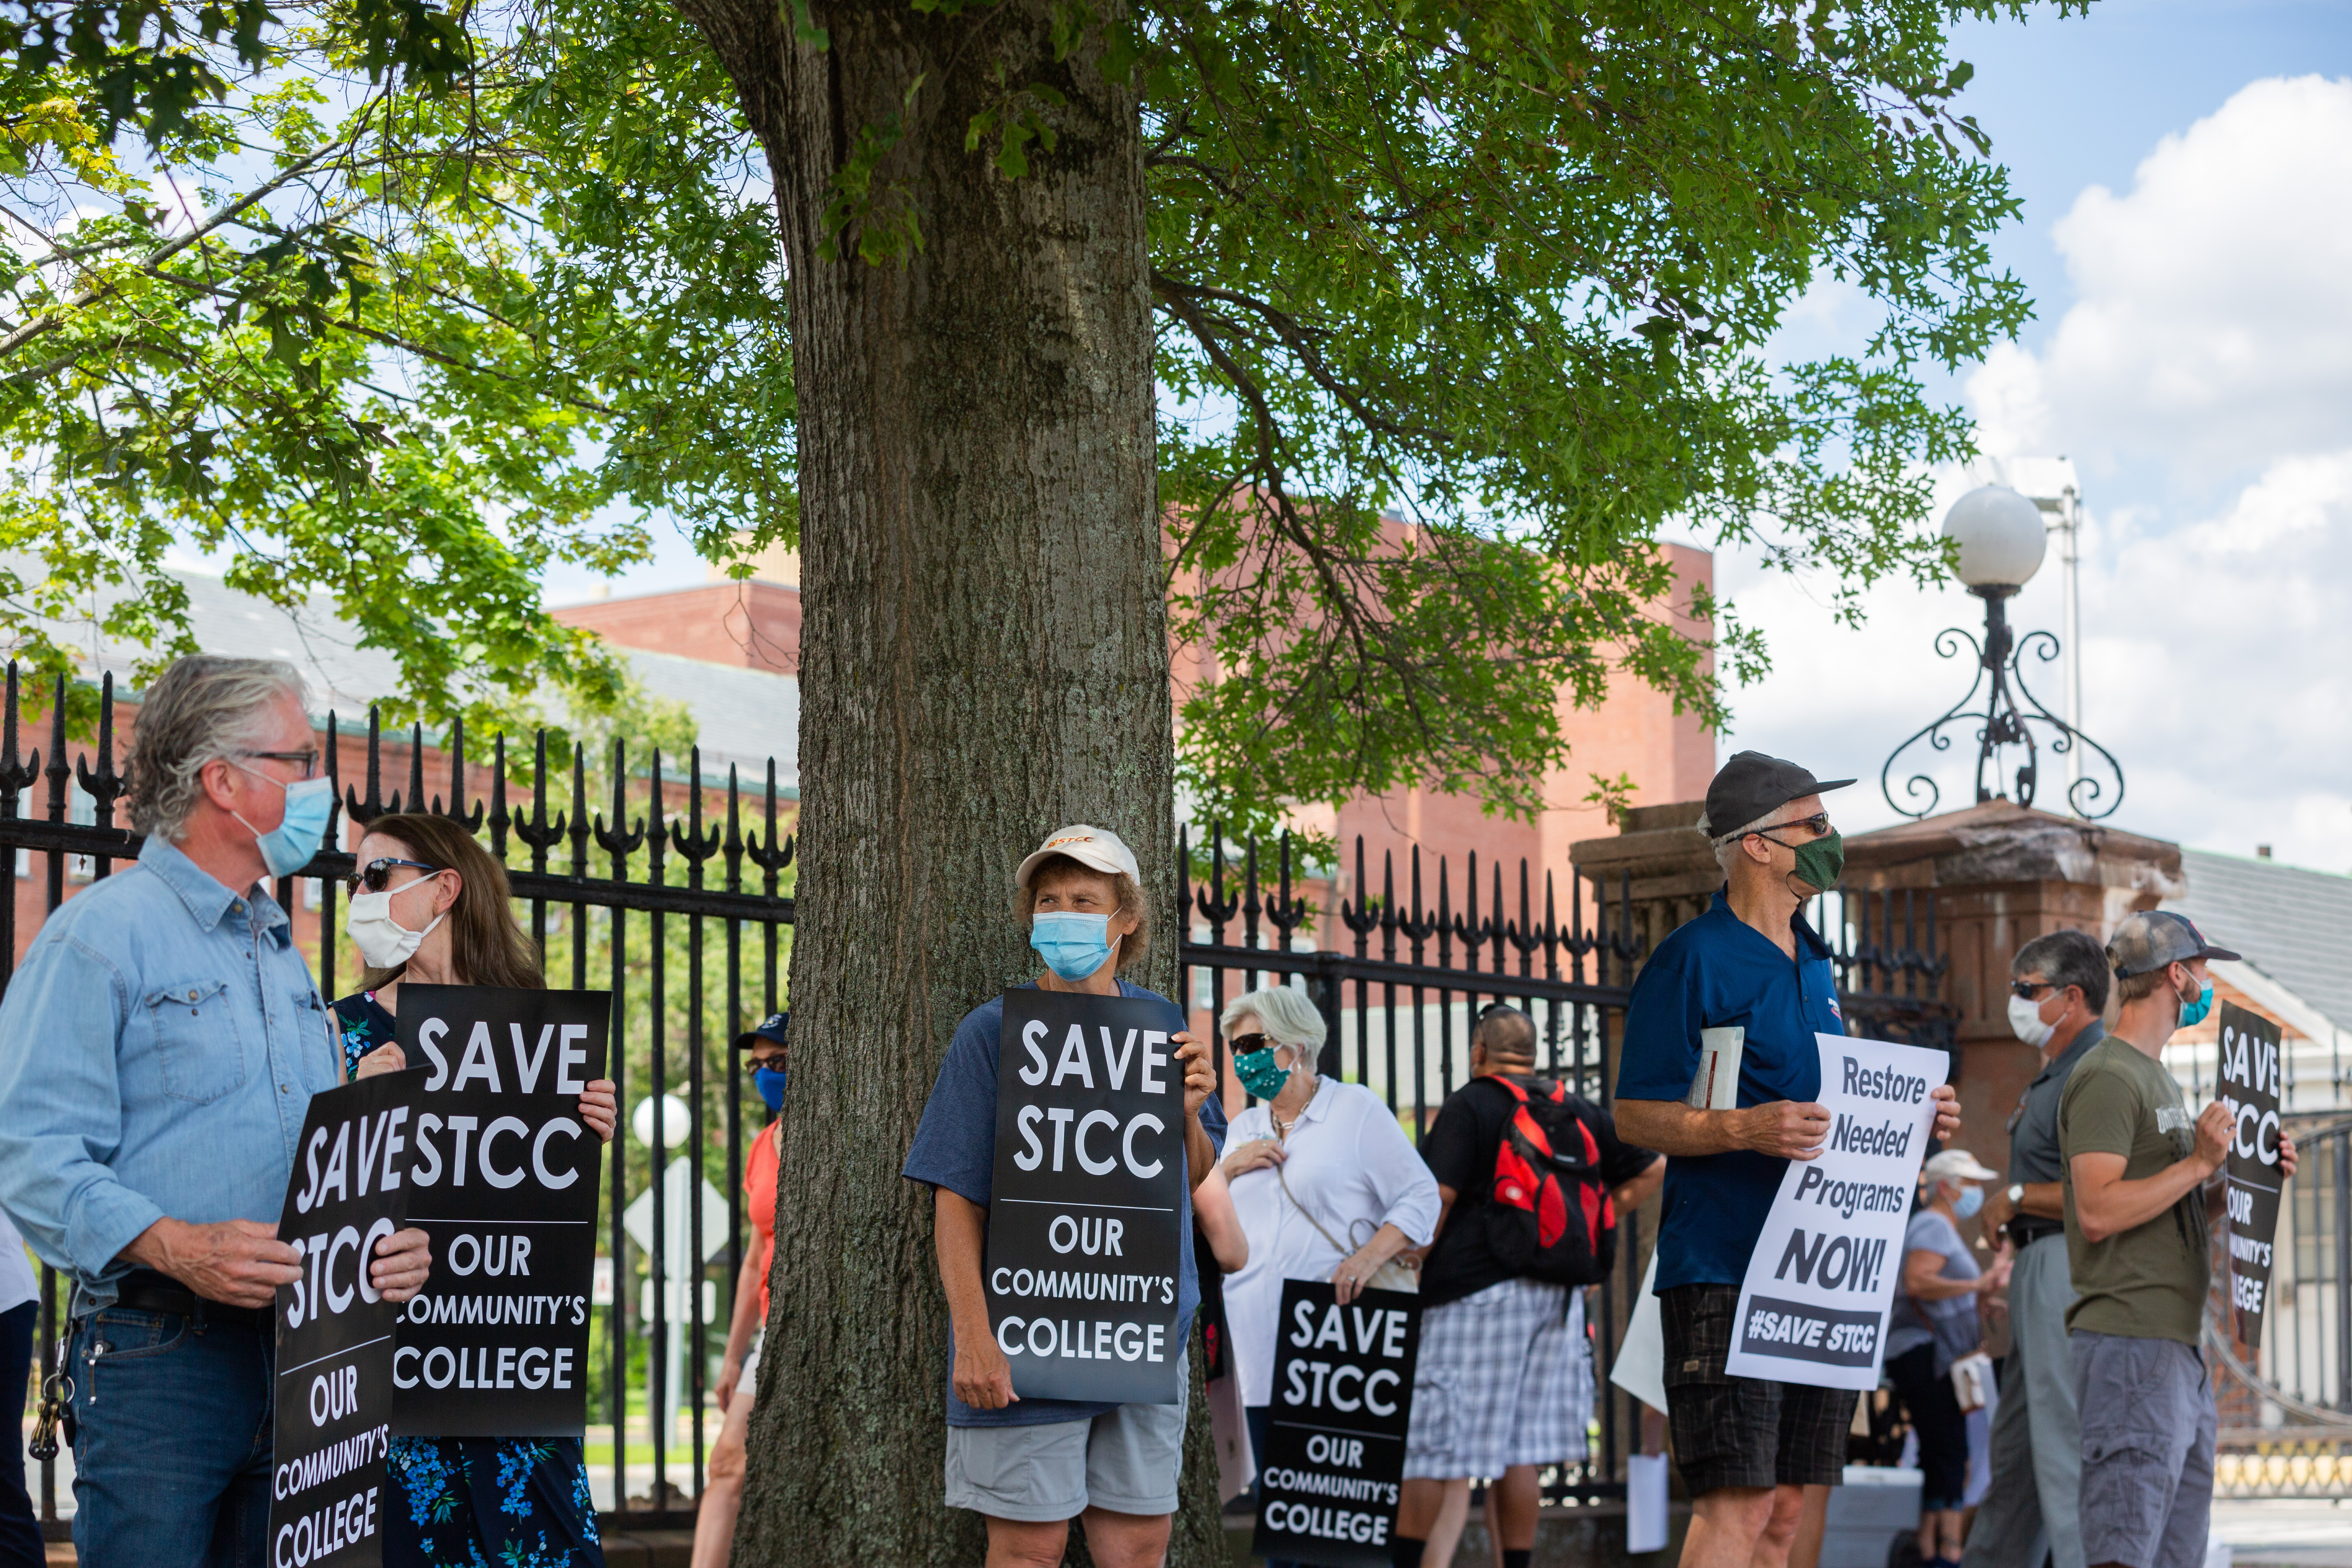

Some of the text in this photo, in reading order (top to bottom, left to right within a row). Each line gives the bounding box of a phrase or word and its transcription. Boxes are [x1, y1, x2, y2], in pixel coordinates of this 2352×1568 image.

[1057, 836, 1094, 845] STCC
[419, 1018, 587, 1094] SAVE
[1018, 1020, 1167, 1094] SAVE
[1843, 1056, 1925, 1104] Restore
[2223, 1026, 2279, 1098] SAVE
[297, 1105, 409, 1214] SAVE
[412, 1113, 581, 1189] STCC
[1013, 1105, 1165, 1178] STCC
[1831, 1114, 1913, 1158] Needed
[1794, 1166, 1904, 1219] Programs
[2227, 1186, 2253, 1225] OUR
[448, 1235, 530, 1276] OUR
[1049, 1215, 1123, 1256] OUR
[1774, 1228, 1887, 1292] NOW!
[287, 1217, 395, 1329] STCC
[992, 1267, 1173, 1304] COMMUNITY'S
[998, 1316, 1164, 1362] COLLEGE
[1290, 1300, 1408, 1358] SAVE
[1748, 1310, 1875, 1353] #SAVE STCC
[393, 1346, 573, 1389] COLLEGE
[1283, 1359, 1401, 1416] STCC
[310, 1365, 358, 1427] OUR
[275, 1424, 389, 1501] COMMUNITY'S
[1307, 1434, 1363, 1468] OUR
[1264, 1467, 1398, 1505] COMMUNITY'S
[275, 1486, 378, 1568] COLLEGE
[1265, 1501, 1389, 1546] COLLEGE
